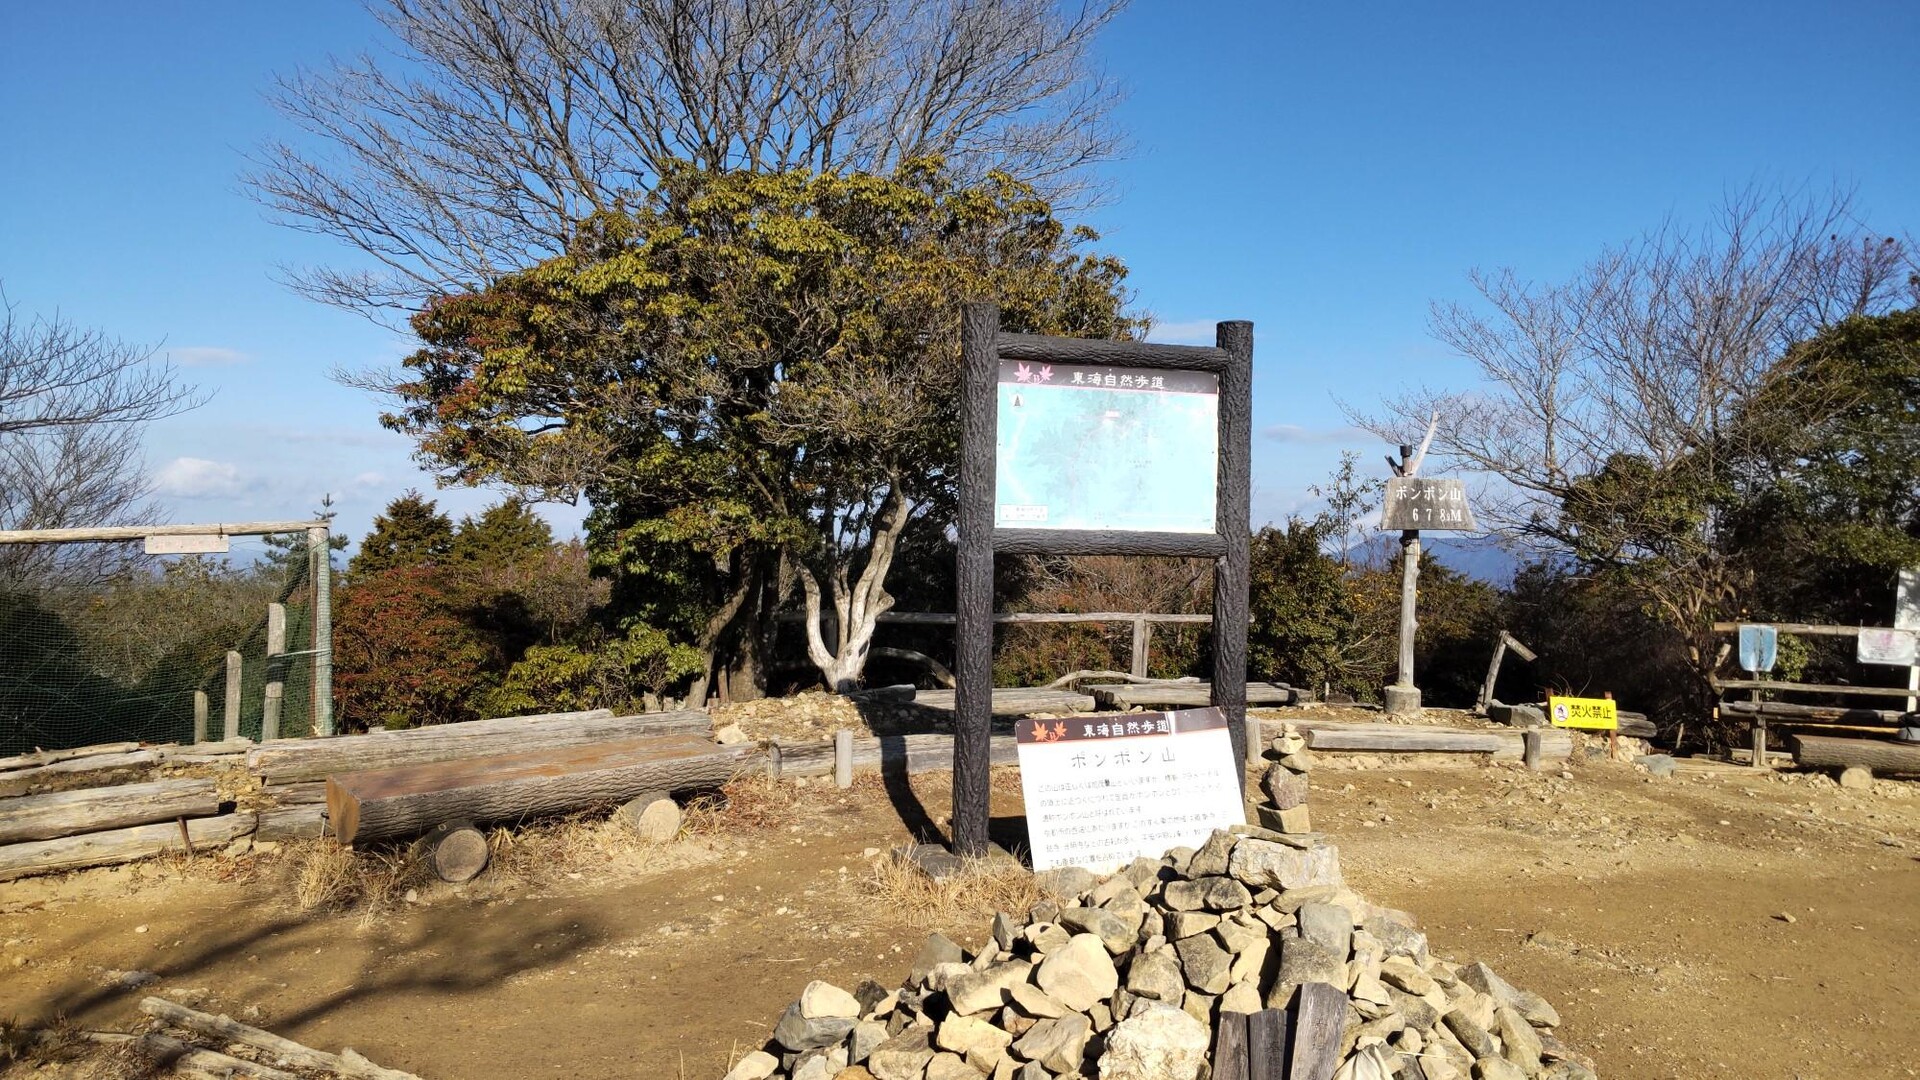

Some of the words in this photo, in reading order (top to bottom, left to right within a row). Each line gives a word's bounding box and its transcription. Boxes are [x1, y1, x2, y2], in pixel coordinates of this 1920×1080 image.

[1071, 371, 1165, 389] 東海自然歩道
[1396, 485, 1462, 501] ポンポン山
[1571, 704, 1612, 719] 焚火禁止
[1083, 719, 1170, 737] 東海自然歩道
[1071, 747, 1175, 769] ポンポン山
